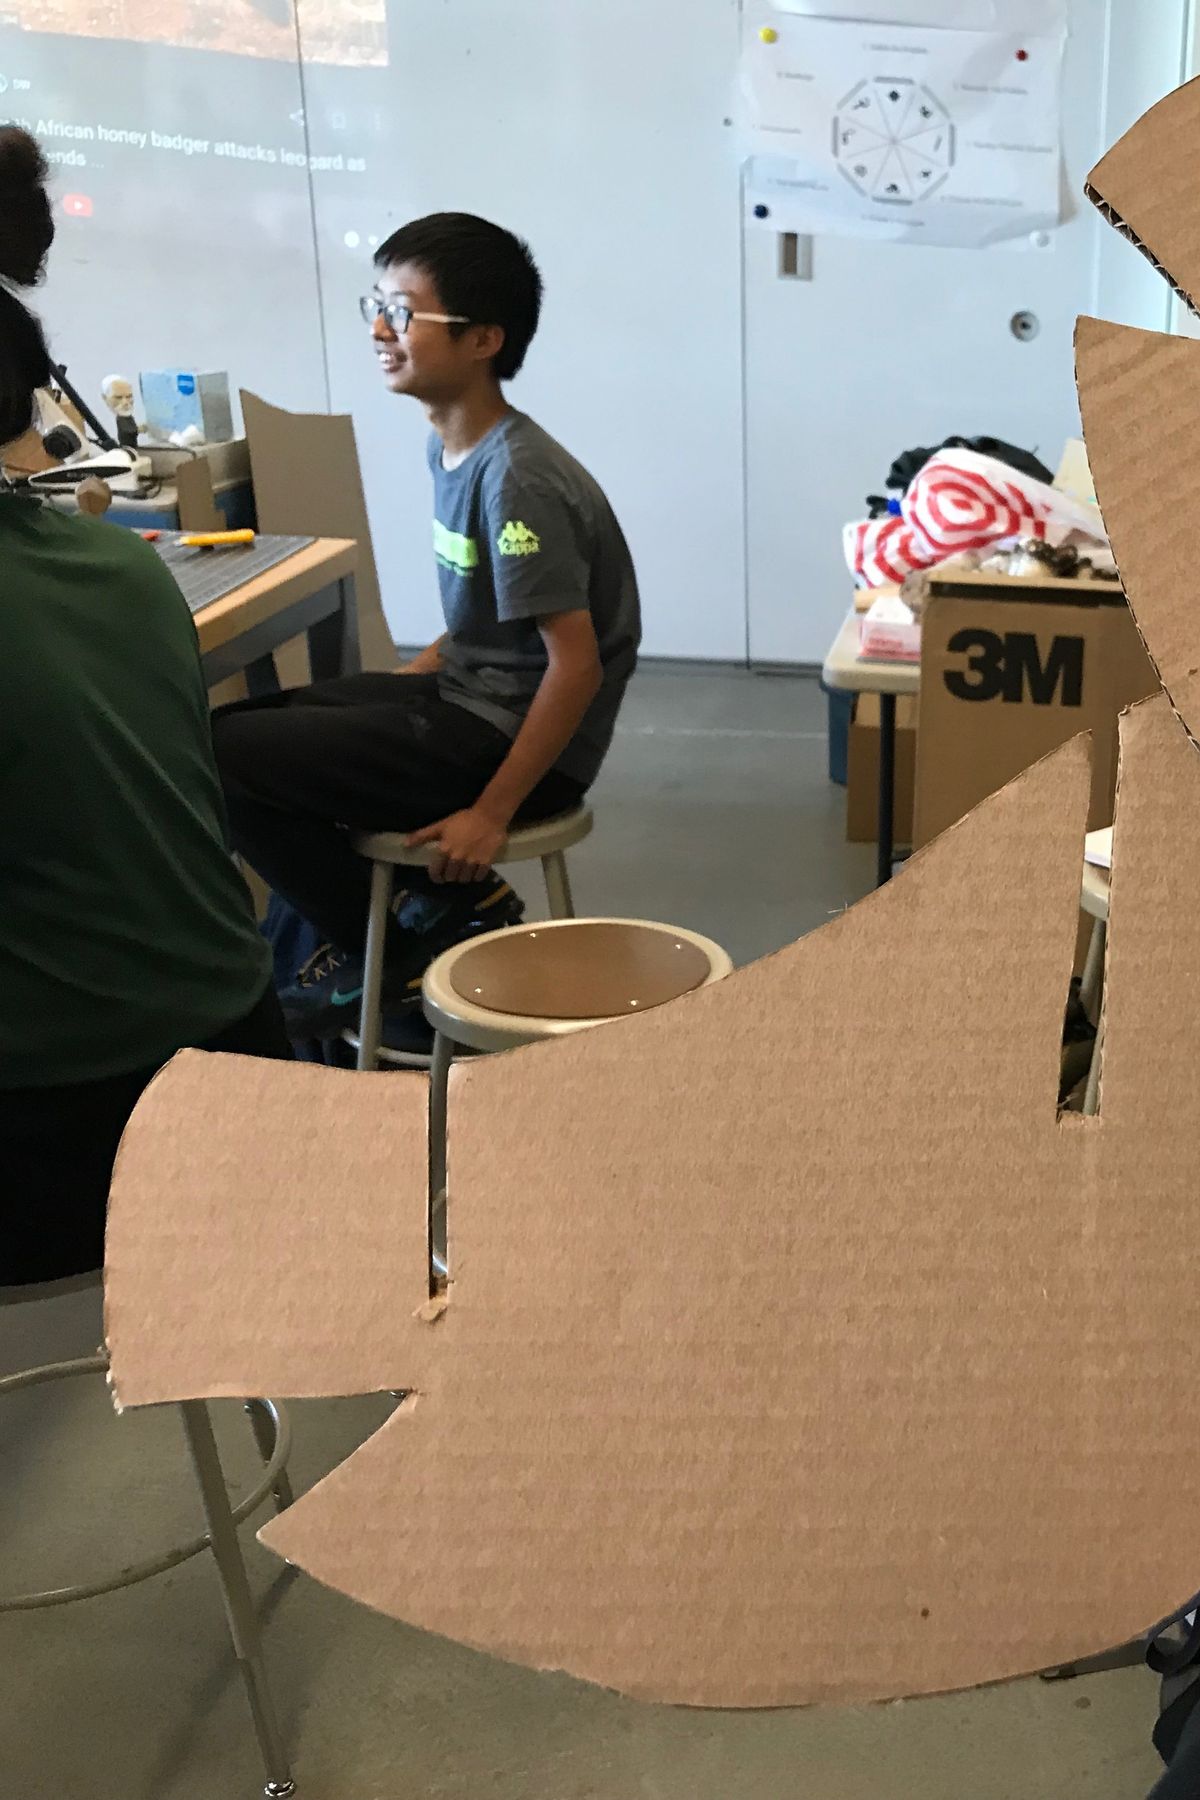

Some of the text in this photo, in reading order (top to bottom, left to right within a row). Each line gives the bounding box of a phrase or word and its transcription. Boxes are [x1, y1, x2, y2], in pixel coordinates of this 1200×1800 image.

[36, 119, 95, 140] African
[98, 124, 148, 149] honey
[151, 131, 209, 156] badger
[214, 141, 276, 163] attacks
[280, 147, 344, 171] leopard
[346, 157, 367, 172] as
[943, 628, 1085, 707] 3M
